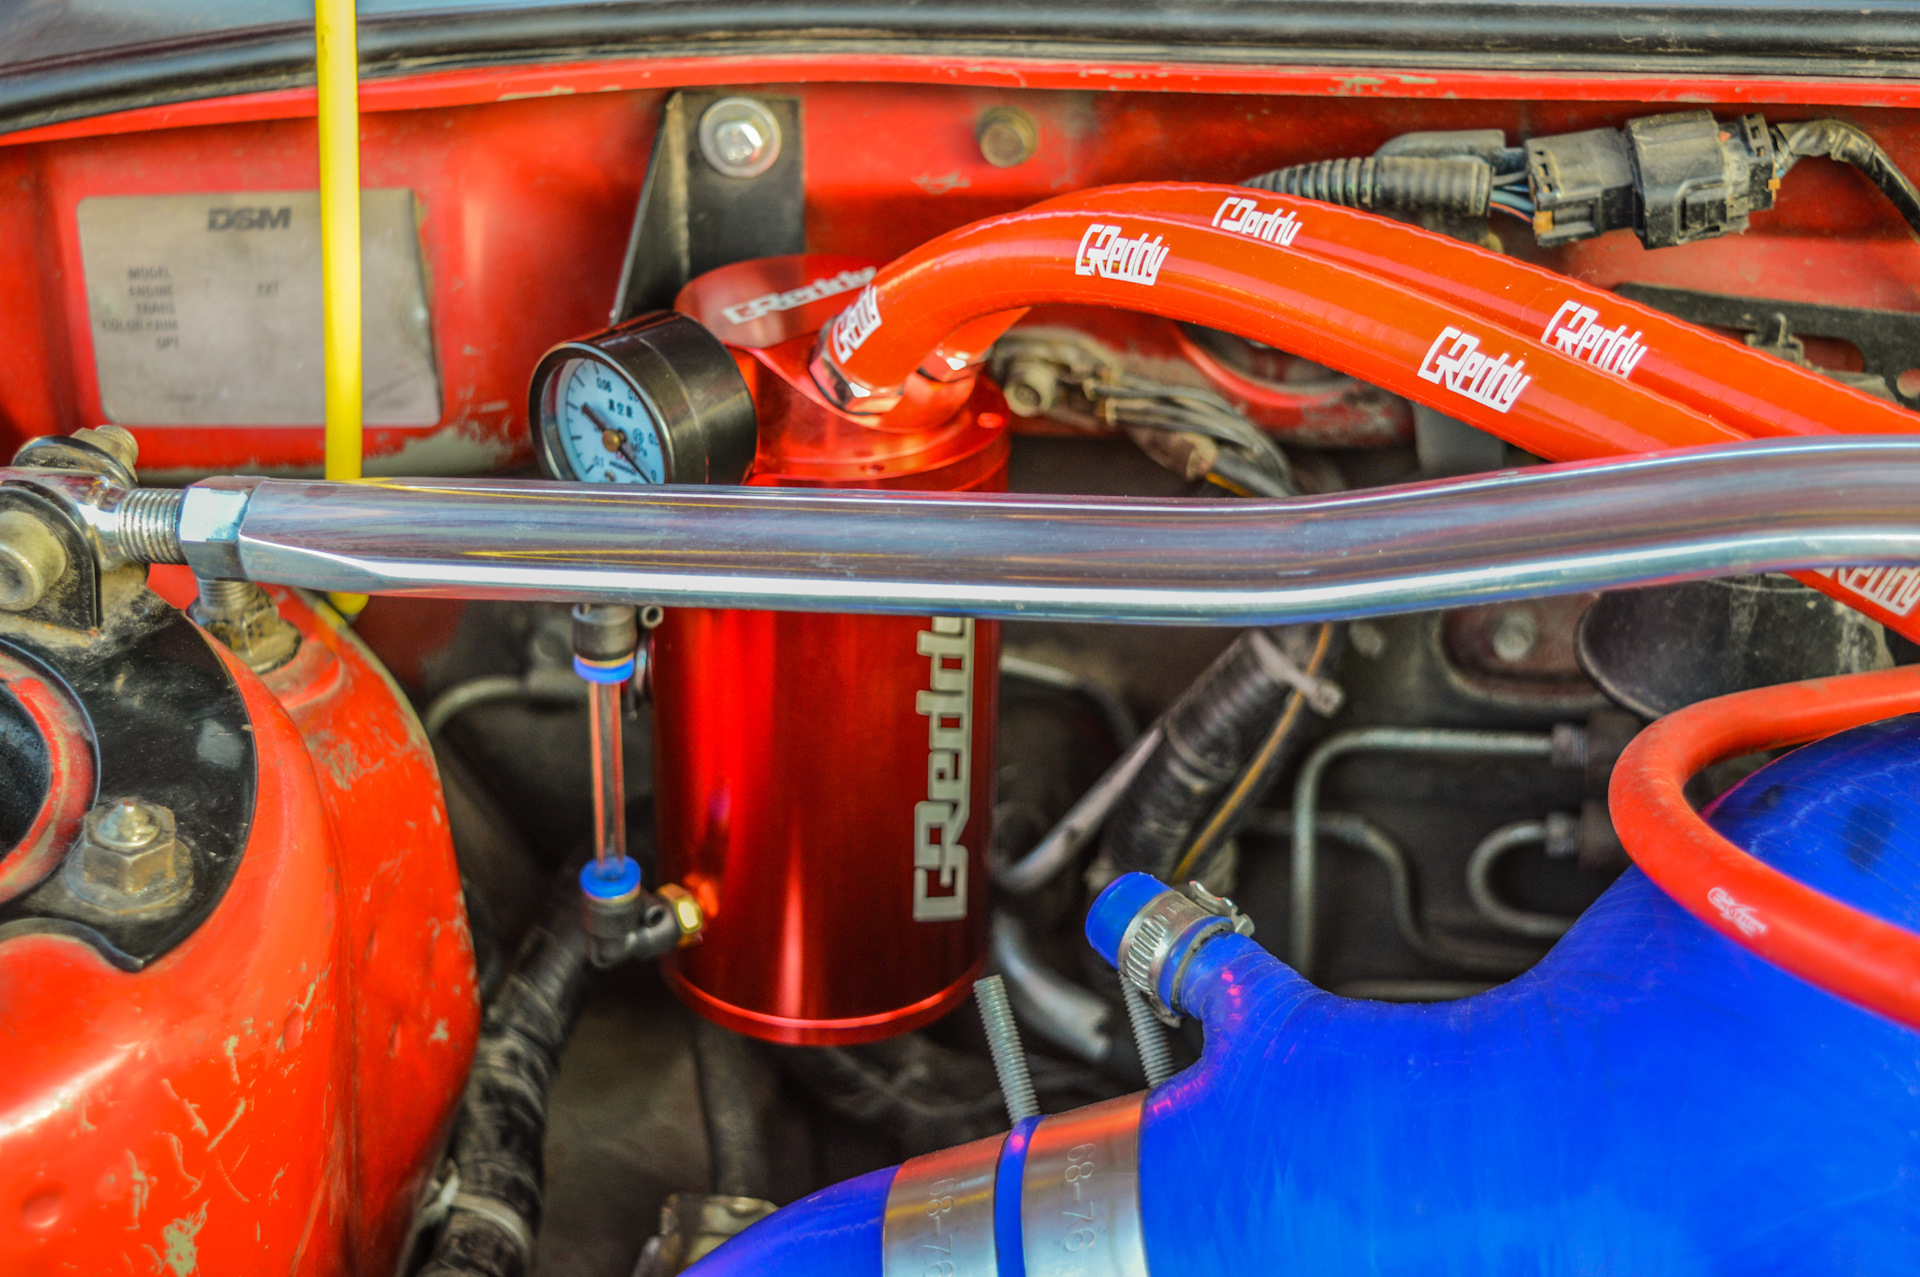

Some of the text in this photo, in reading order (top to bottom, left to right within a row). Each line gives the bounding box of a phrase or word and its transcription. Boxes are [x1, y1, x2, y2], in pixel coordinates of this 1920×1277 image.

[207, 207, 292, 231] DSM
[128, 266, 170, 280] MODEL
[1075, 223, 1170, 286] GReddy
[128, 284, 173, 298] ENGINE
[722, 266, 876, 325] GReddy
[1540, 299, 1648, 380] GReddy
[1416, 325, 1531, 414] GReddy
